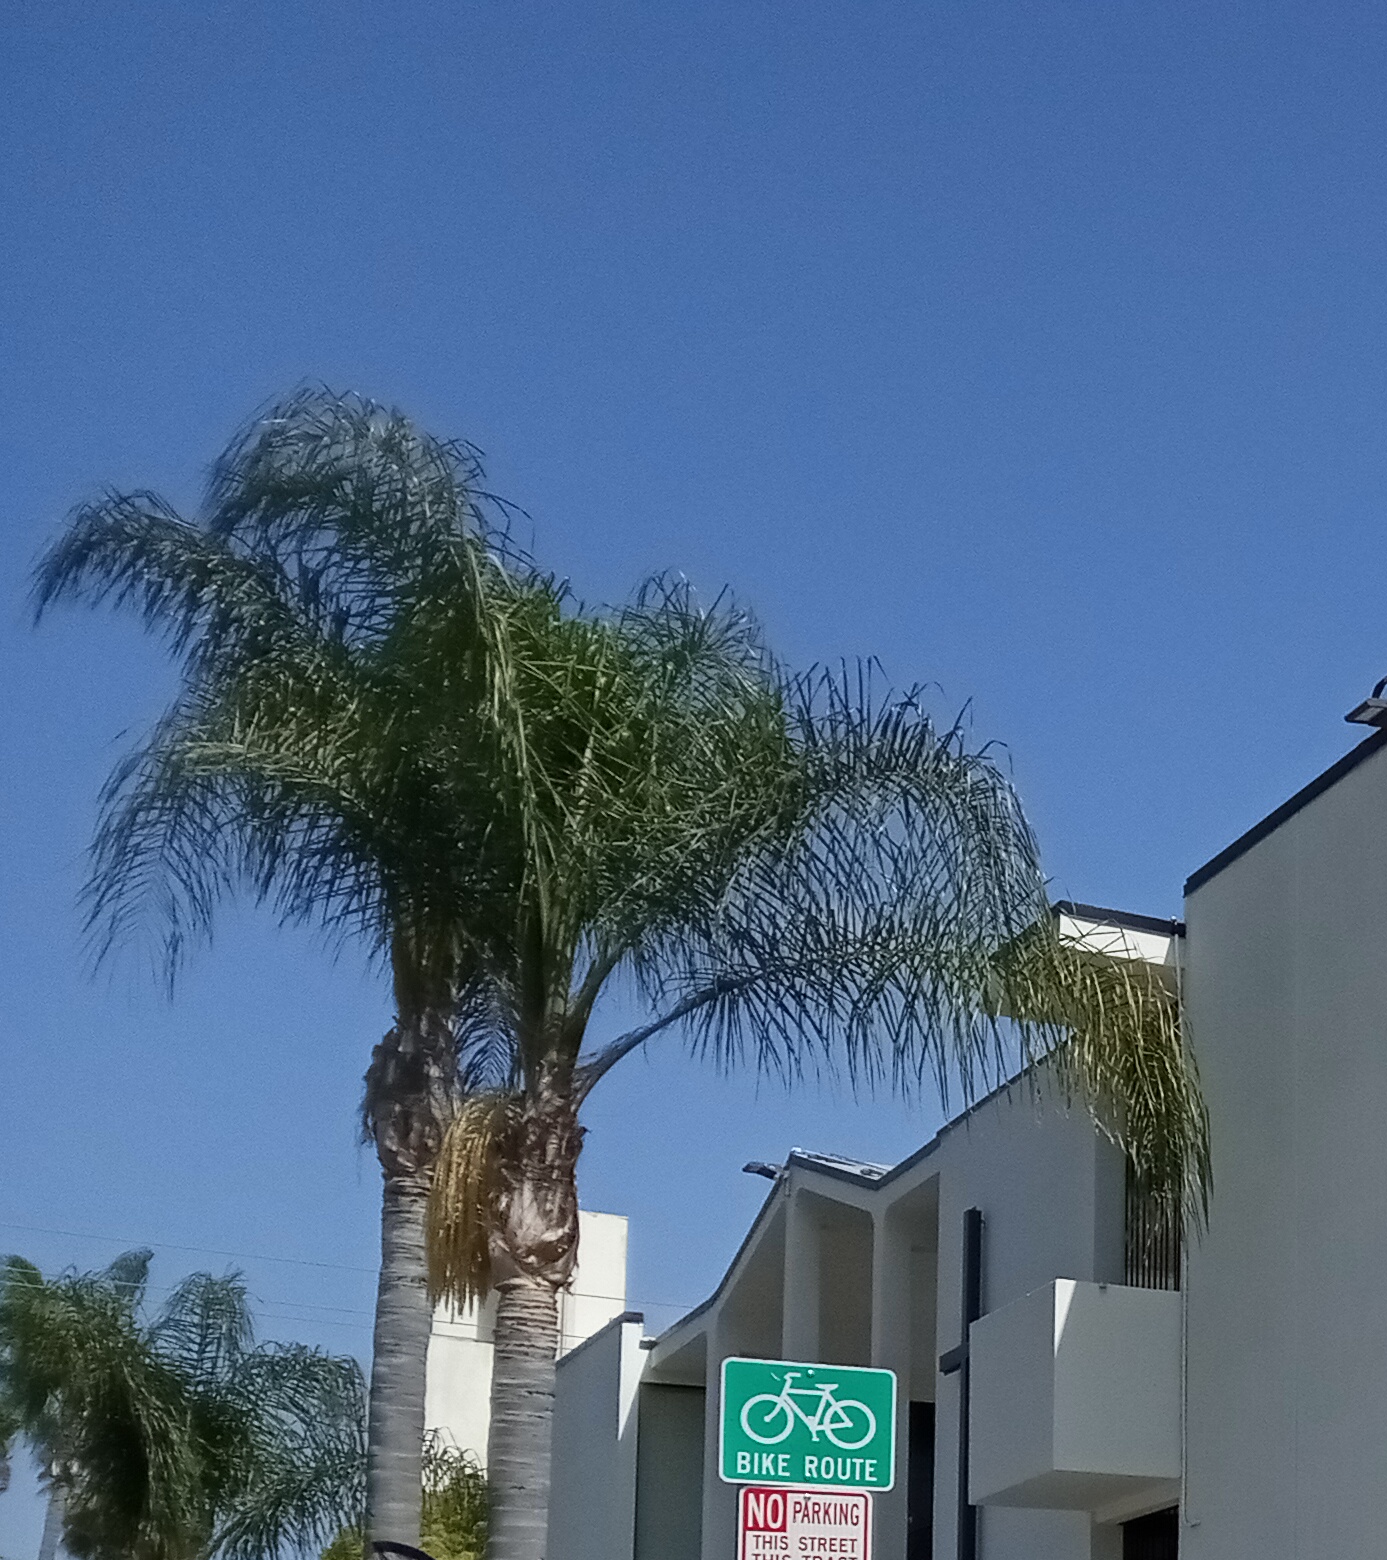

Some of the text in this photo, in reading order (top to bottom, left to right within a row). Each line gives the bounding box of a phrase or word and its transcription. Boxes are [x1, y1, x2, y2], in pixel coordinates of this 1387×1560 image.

[736, 1451, 878, 1482] BIKE ROUTE
[747, 1492, 860, 1530] NO PARKING
[752, 1534, 858, 1553] THIS STREET
